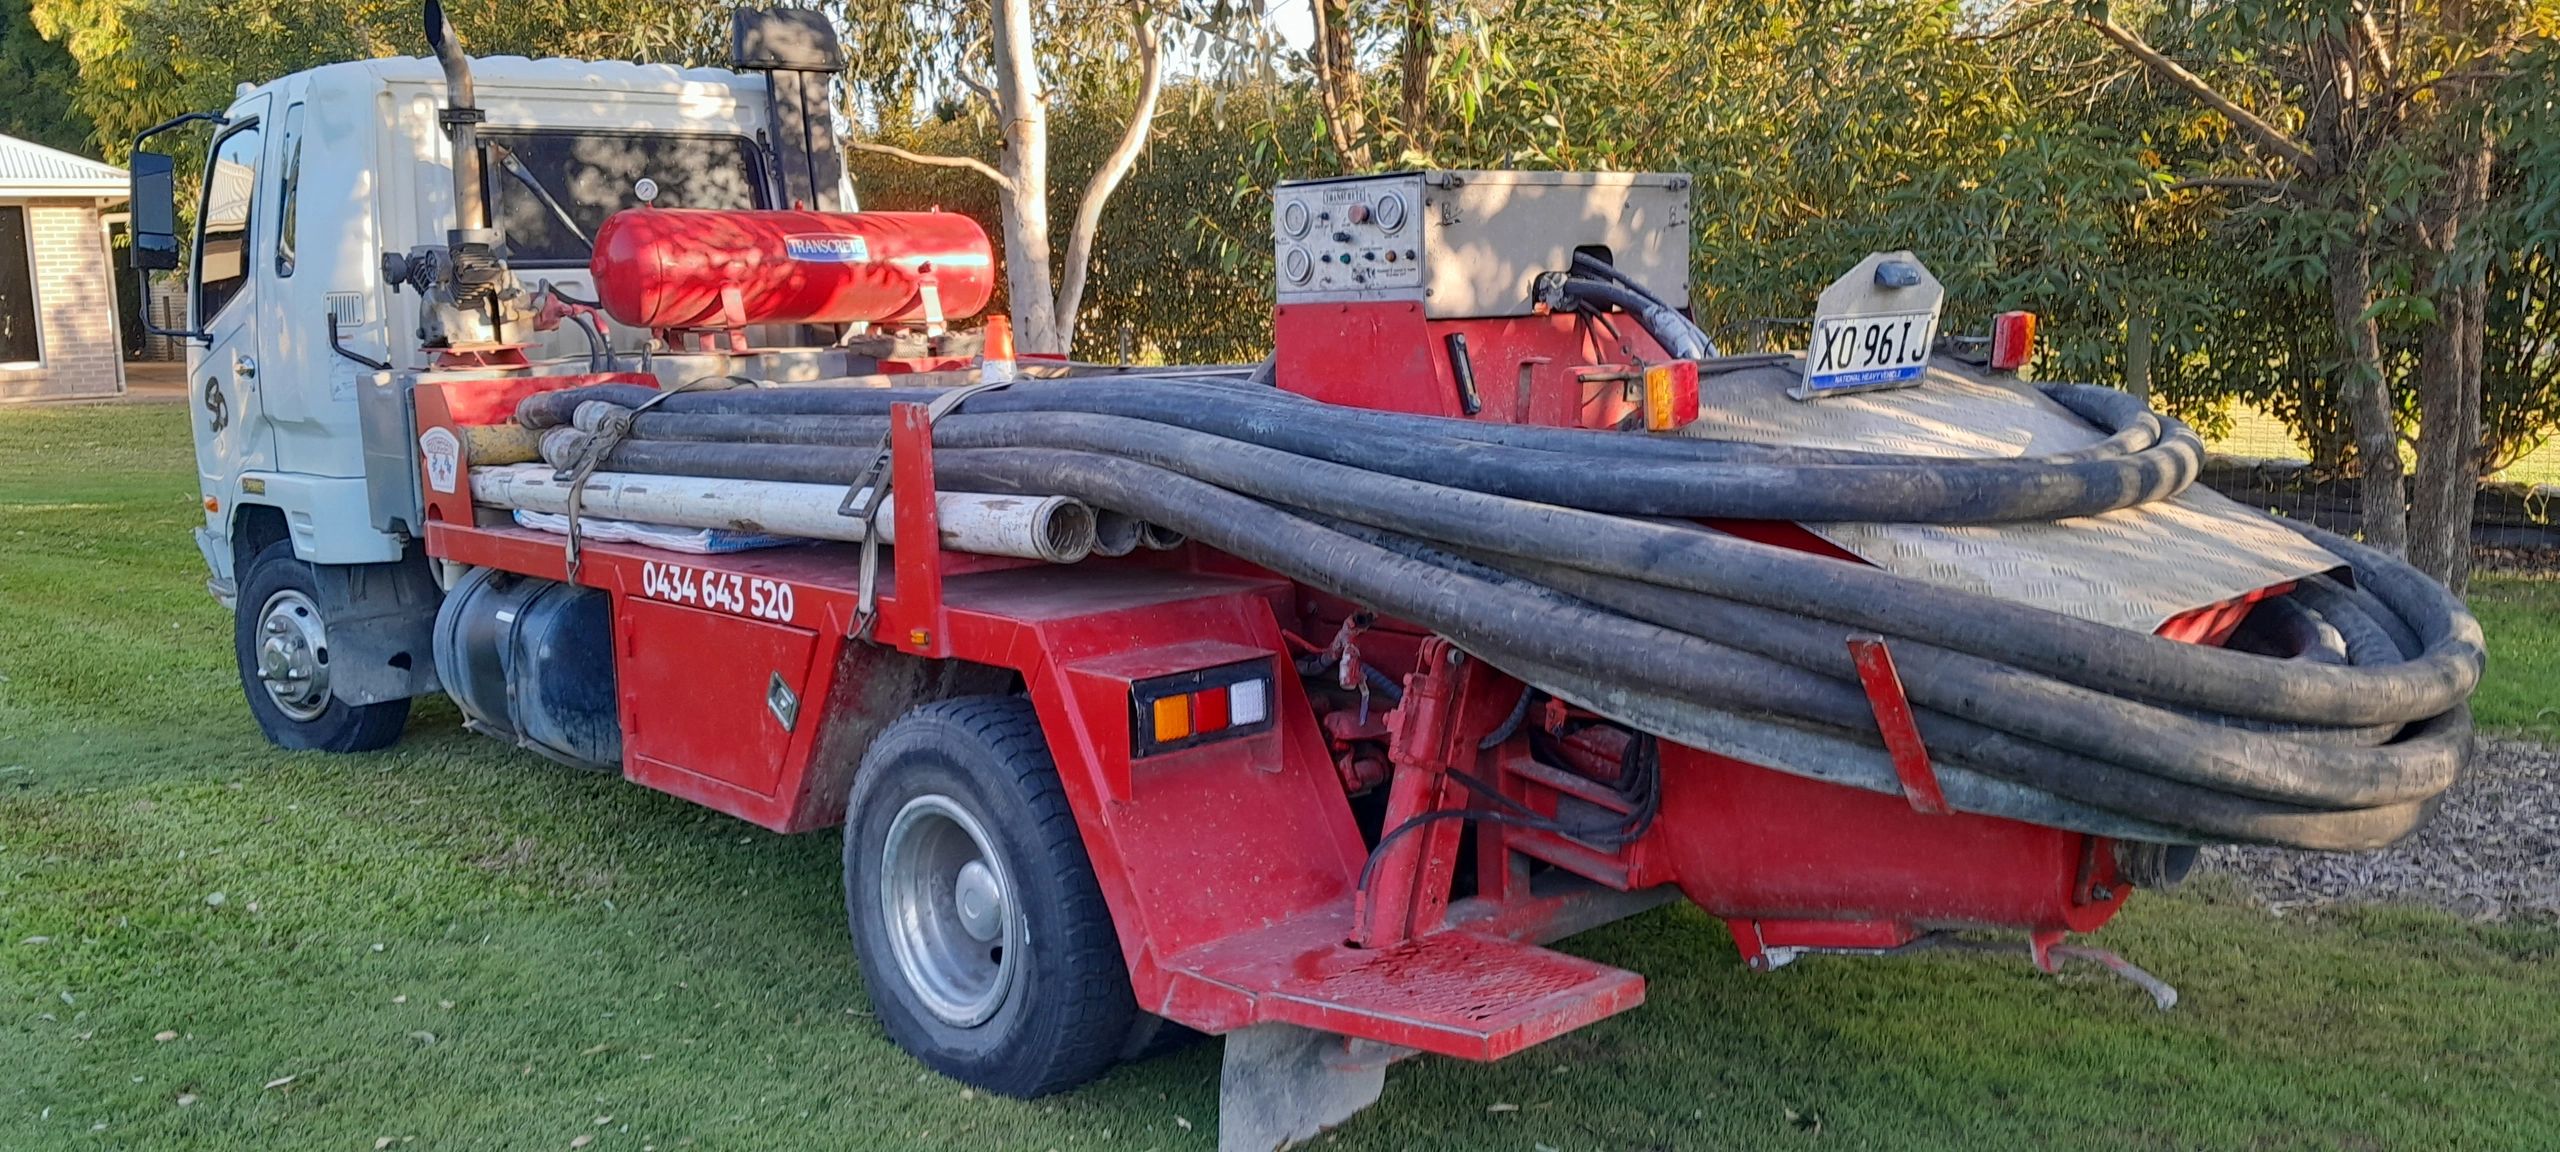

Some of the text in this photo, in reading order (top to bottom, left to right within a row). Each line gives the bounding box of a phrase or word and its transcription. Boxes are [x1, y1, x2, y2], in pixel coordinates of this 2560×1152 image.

[787, 239, 866, 254] TRANSCRETE
[1834, 374, 1861, 384] NATIONAL
[1862, 372, 1881, 381] HEAVY
[1880, 370, 1901, 380] VEHICLE
[643, 561, 794, 622] 0434 643 520
